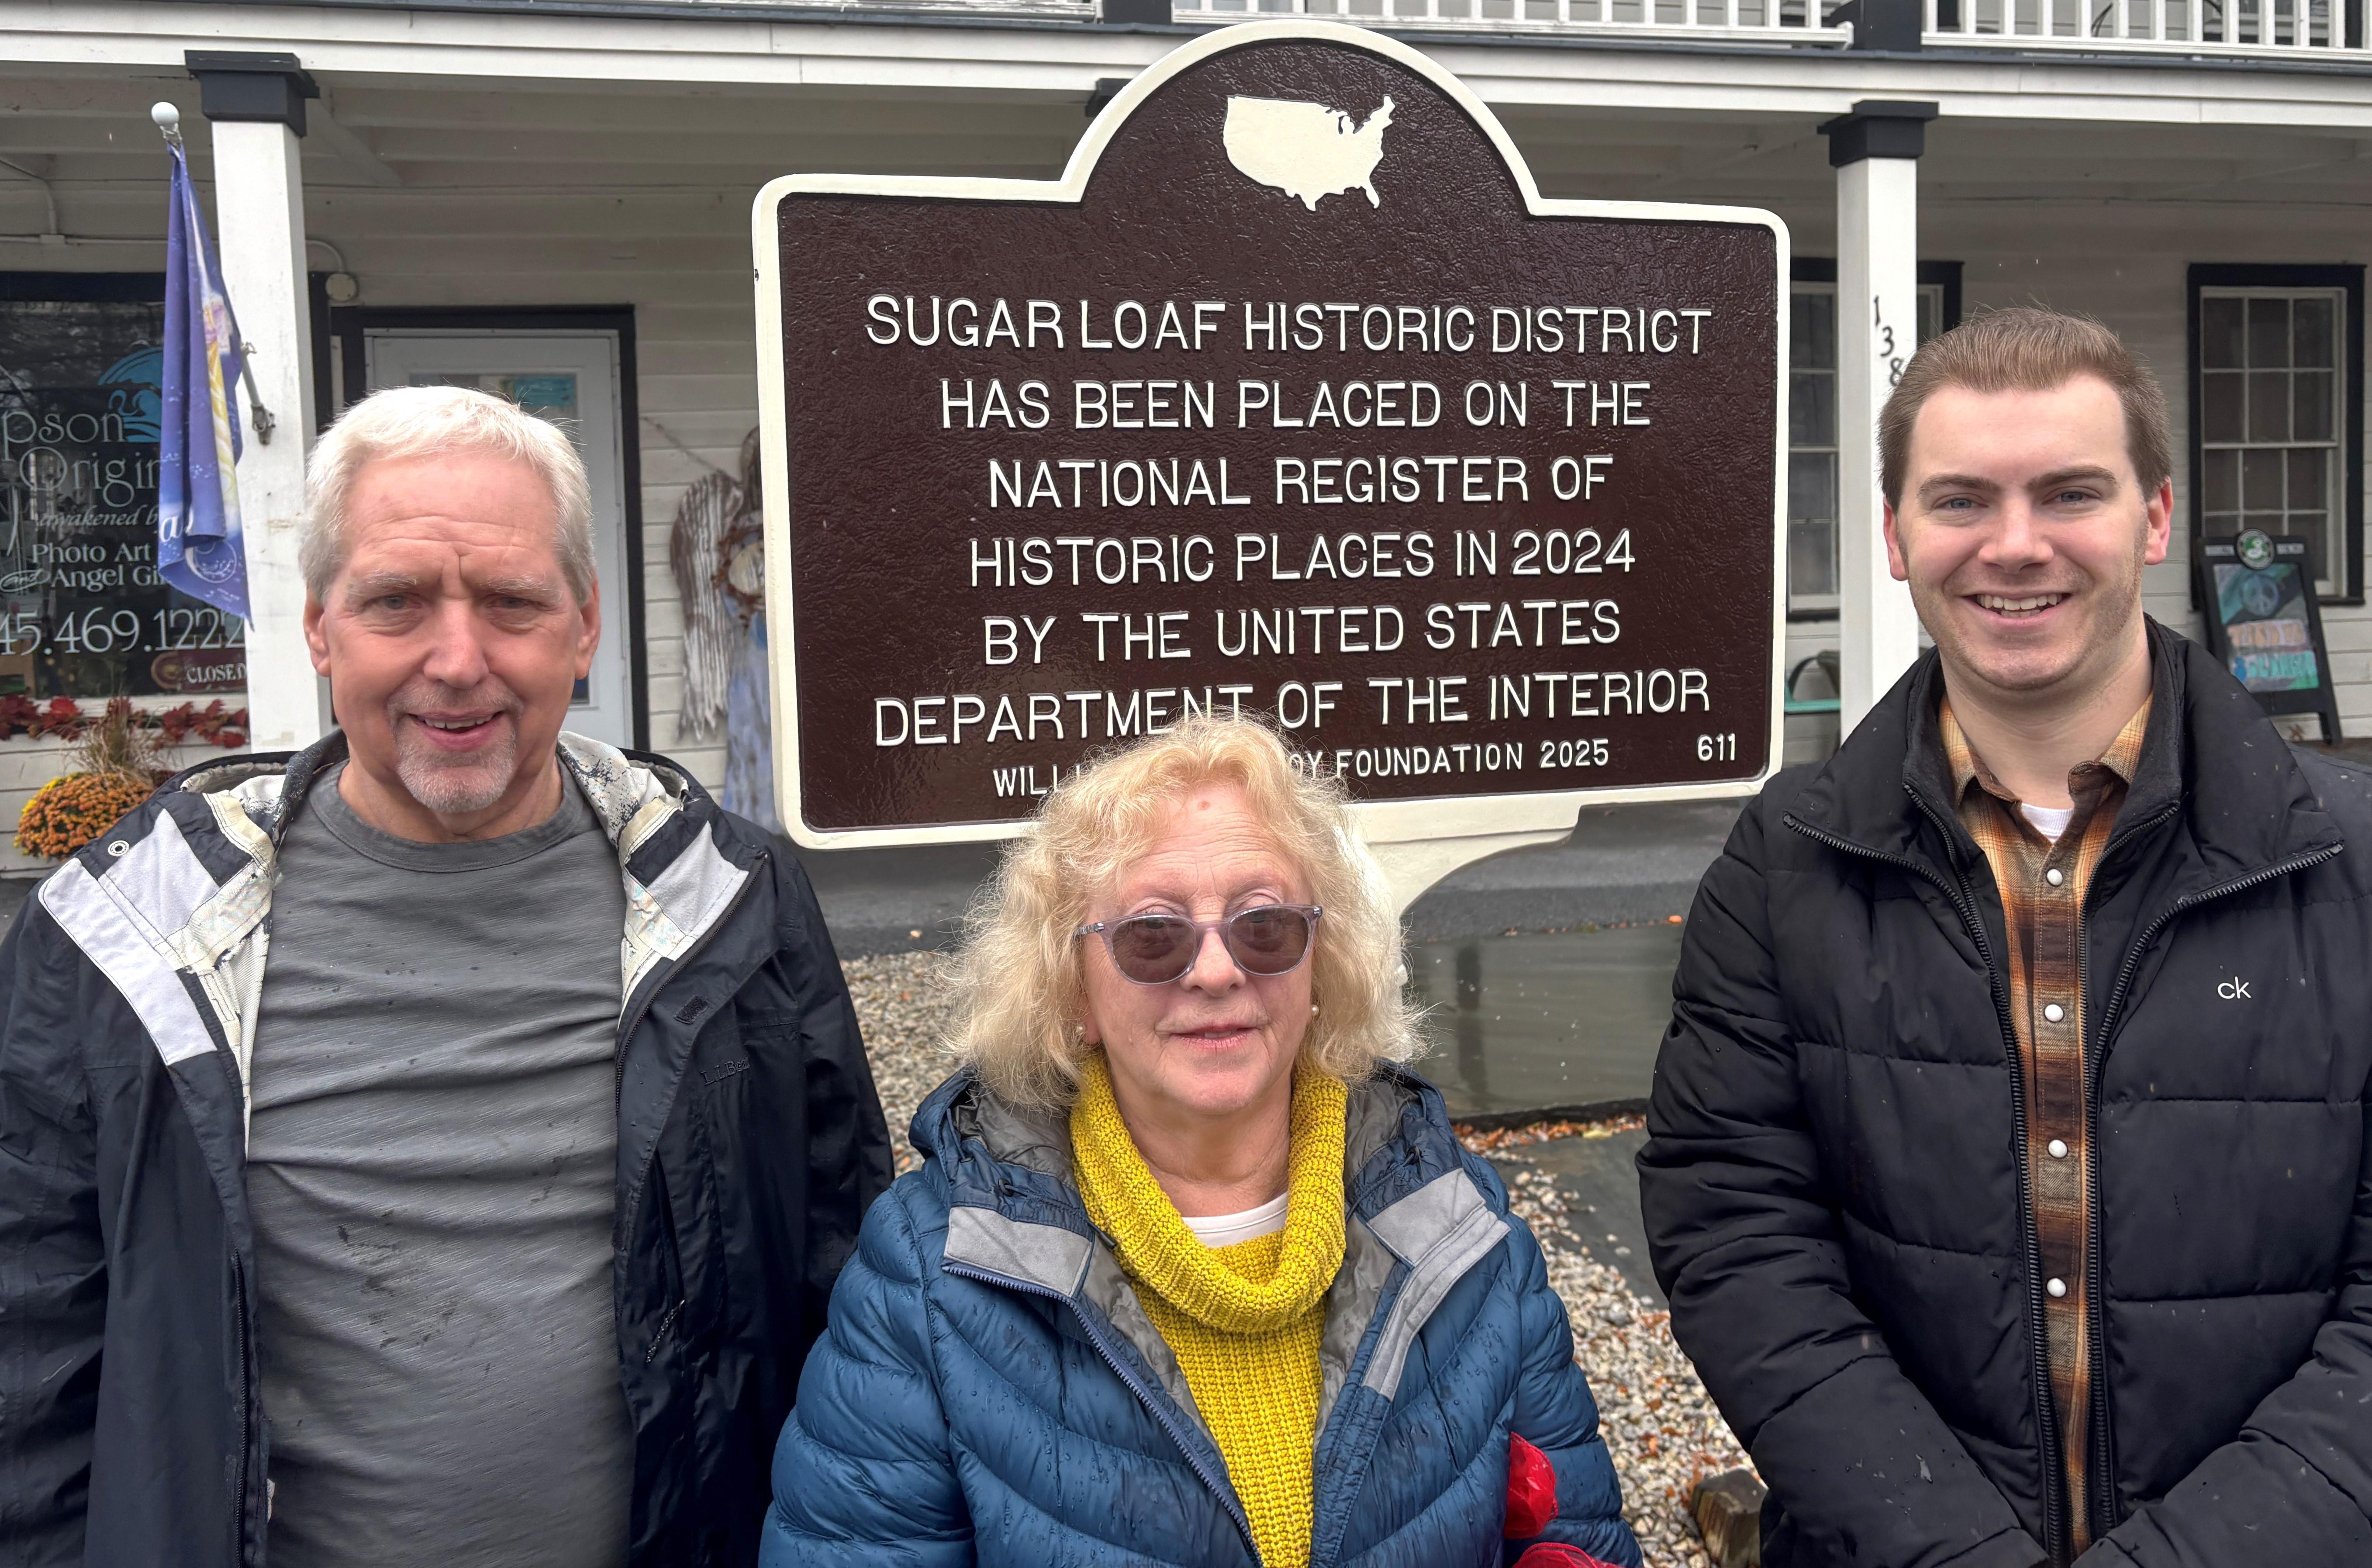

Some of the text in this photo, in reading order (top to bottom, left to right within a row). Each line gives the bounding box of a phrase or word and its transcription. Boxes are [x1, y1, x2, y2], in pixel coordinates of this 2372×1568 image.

[866, 295, 1713, 355] SUGAR LOAF HISTORIC DISTRICT
[941, 379, 1651, 430] HAS BEEN PLACED ON THE
[989, 456, 1614, 508] NATIONAL REGISTER OF
[33, 542, 151, 563] Photo Art
[971, 529, 1636, 587] HISTORIC PLACES IN 2024
[51, 565, 123, 592] Angel
[984, 600, 1621, 665] BY THE UNITED STATES
[186, 663, 247, 684] CLOSED
[875, 670, 1710, 746] DEPARTMENT OF THE INTERIOR
[1336, 742, 1523, 779] FOUNDATION
[1540, 738, 1609, 769] 2025
[1697, 732, 1736, 762] 611
[2217, 976, 2252, 999] ck
